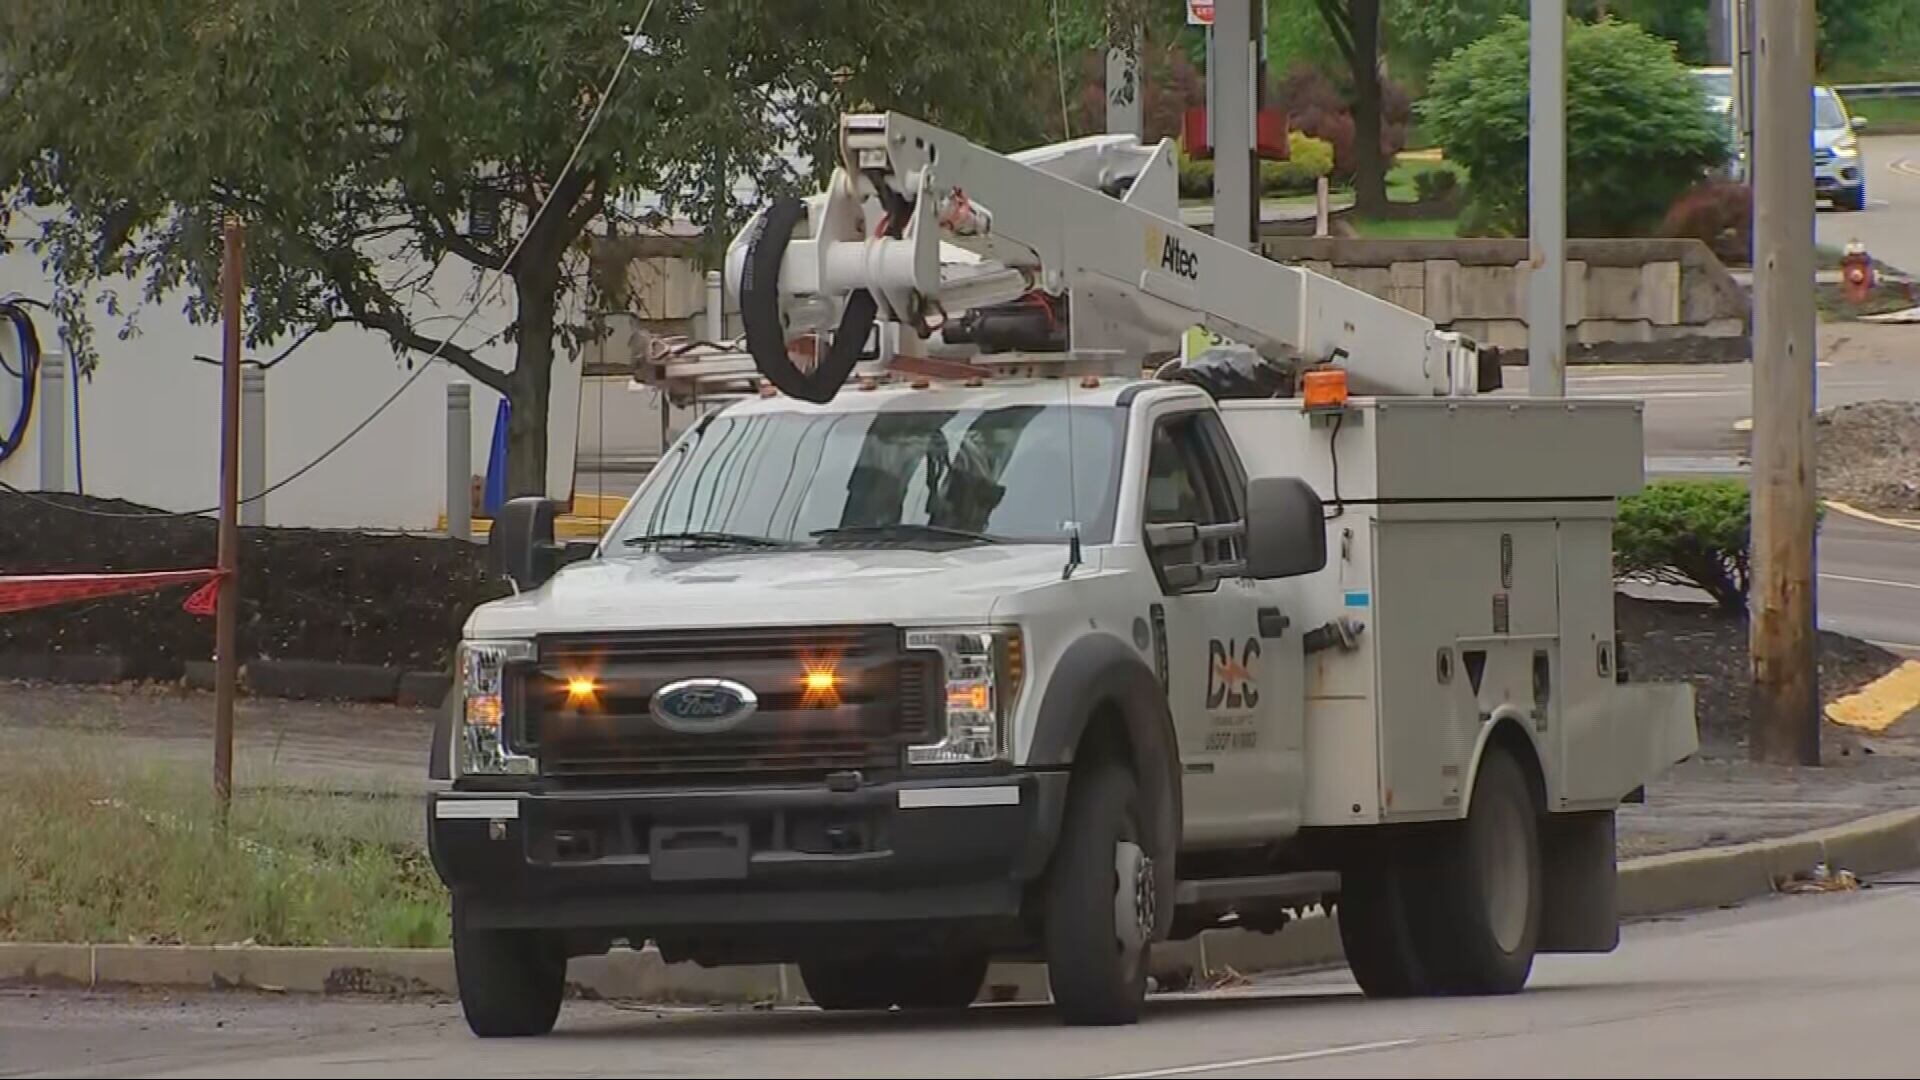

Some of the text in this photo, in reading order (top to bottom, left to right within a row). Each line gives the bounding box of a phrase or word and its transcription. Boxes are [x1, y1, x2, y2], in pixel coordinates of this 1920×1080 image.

[1161, 234, 1198, 280] Altec
[1206, 637, 1261, 709] DLC
[676, 687, 729, 715] Ford
